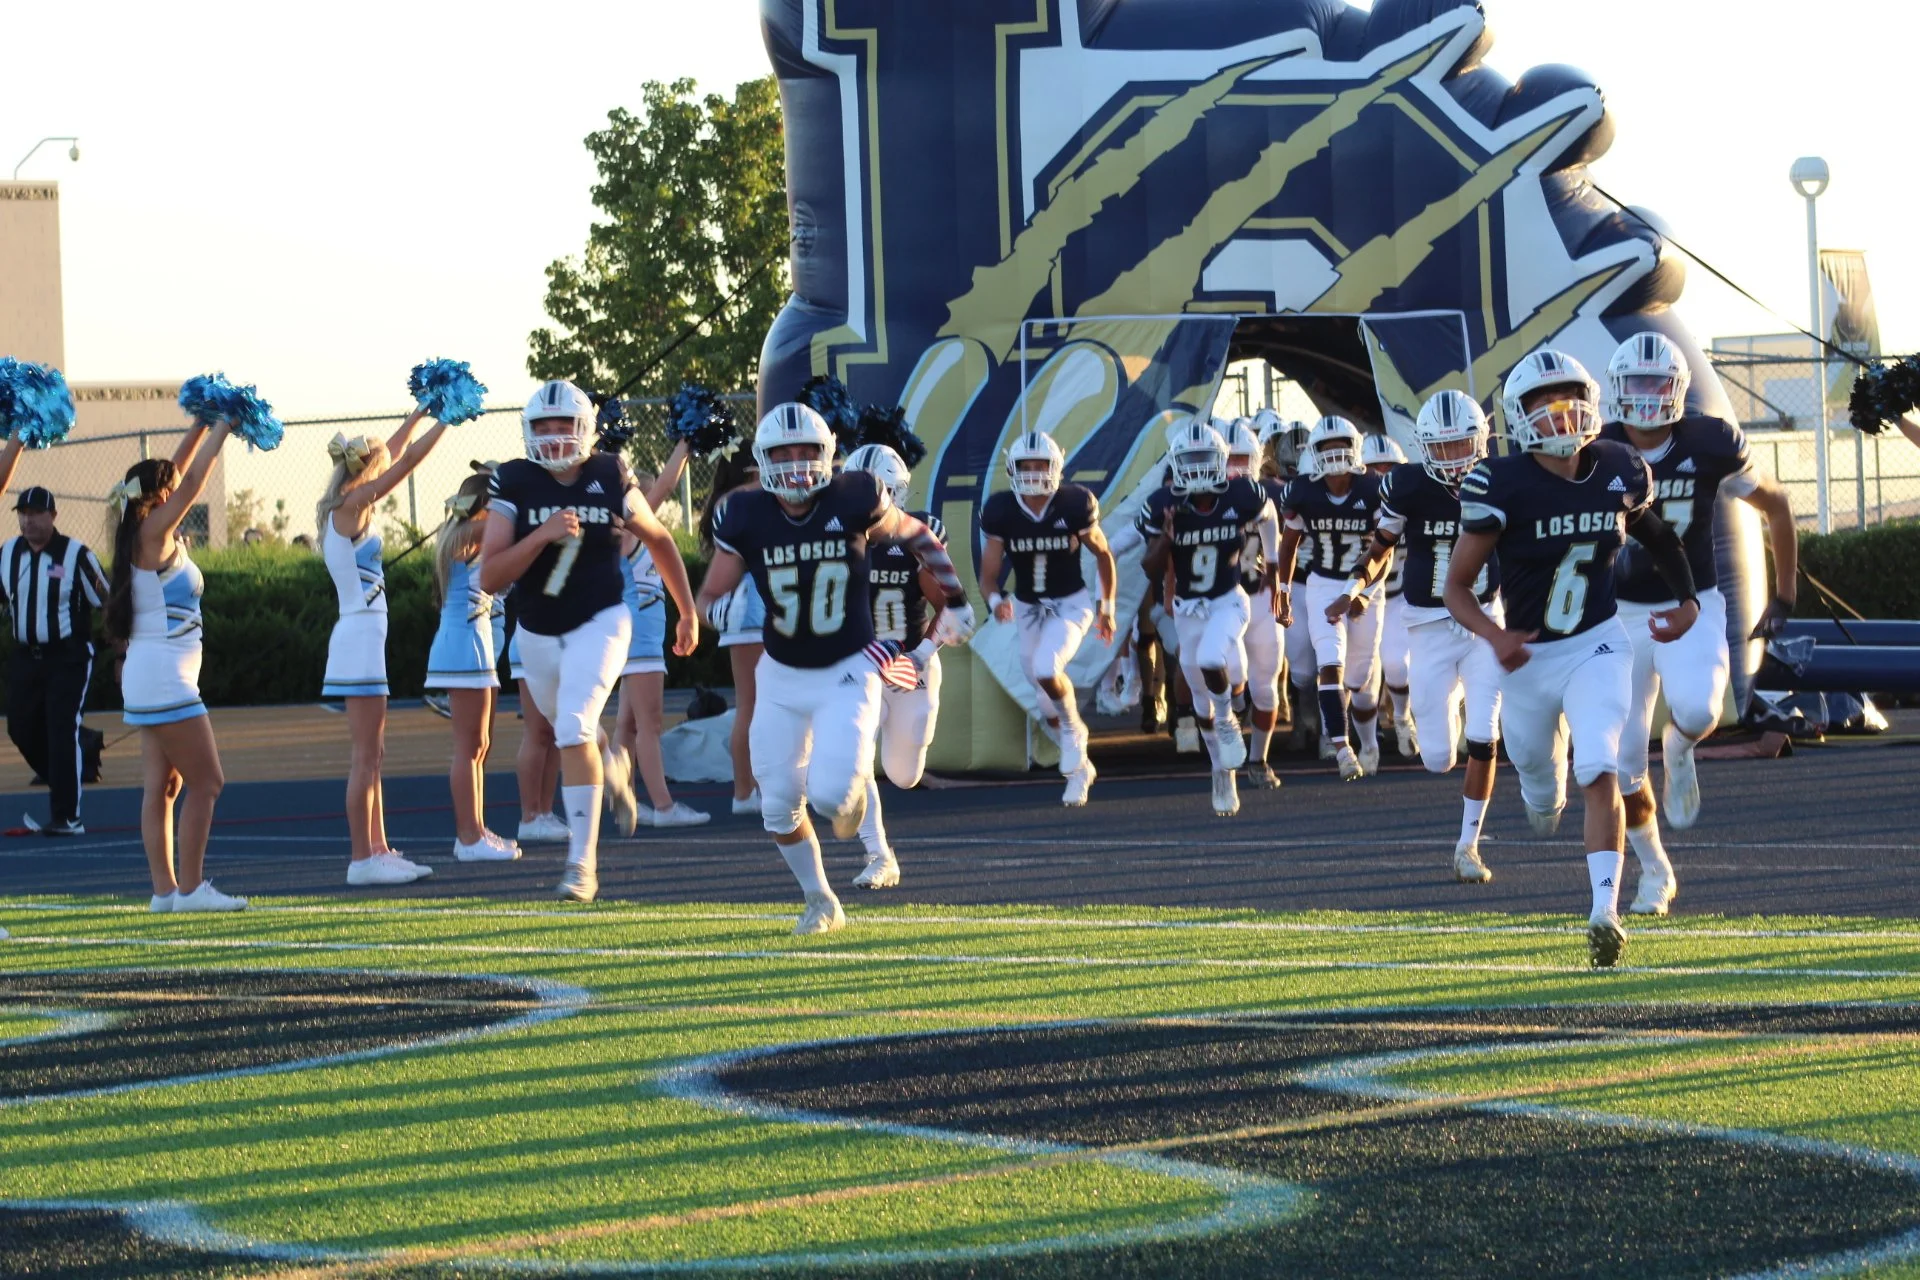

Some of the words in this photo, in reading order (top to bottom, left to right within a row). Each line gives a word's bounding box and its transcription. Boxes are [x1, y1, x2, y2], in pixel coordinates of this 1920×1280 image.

[565, 506, 610, 524] SOS
[1310, 518, 1333, 531] LOS
[1335, 518, 1367, 531] OSOS
[1535, 514, 1574, 539] LOS
[1578, 511, 1620, 533] OSO
[1174, 530, 1200, 547] LOS
[1202, 524, 1236, 543] OSOS
[1423, 520, 1455, 536] LOS
[763, 544, 796, 567] LOS
[799, 539, 847, 561] OSOS
[1010, 537, 1034, 552] LOS
[1036, 535, 1069, 551] OSOS
[869, 569, 910, 584] OSOS
[1032, 553, 1047, 592] 1
[1189, 545, 1218, 593] 9
[767, 560, 851, 639] 50
[1543, 541, 1598, 635] 6
